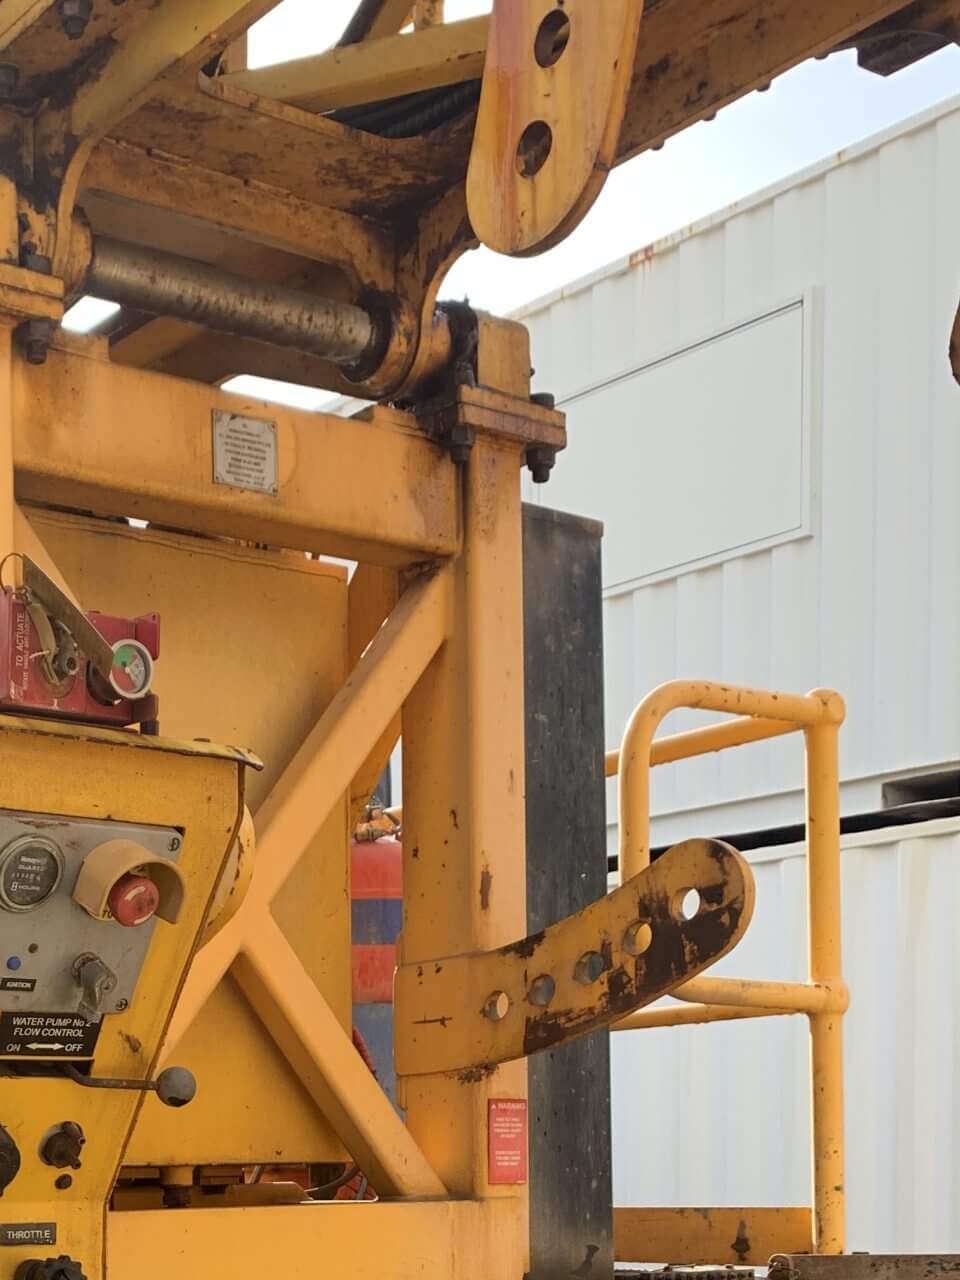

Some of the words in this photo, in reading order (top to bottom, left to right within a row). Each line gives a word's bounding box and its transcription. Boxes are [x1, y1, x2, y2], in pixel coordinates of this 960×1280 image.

[16, 612, 24, 651] ACTUATE
[12, 1016, 44, 1026] WATER
[45, 1018, 72, 1026] PUMP
[14, 1028, 41, 1036] FLOW
[42, 1028, 84, 1038] CONTROL
[6, 1044, 21, 1052] ON
[64, 1044, 84, 1052] OFF
[8, 1230, 51, 1240] THROTTLE
